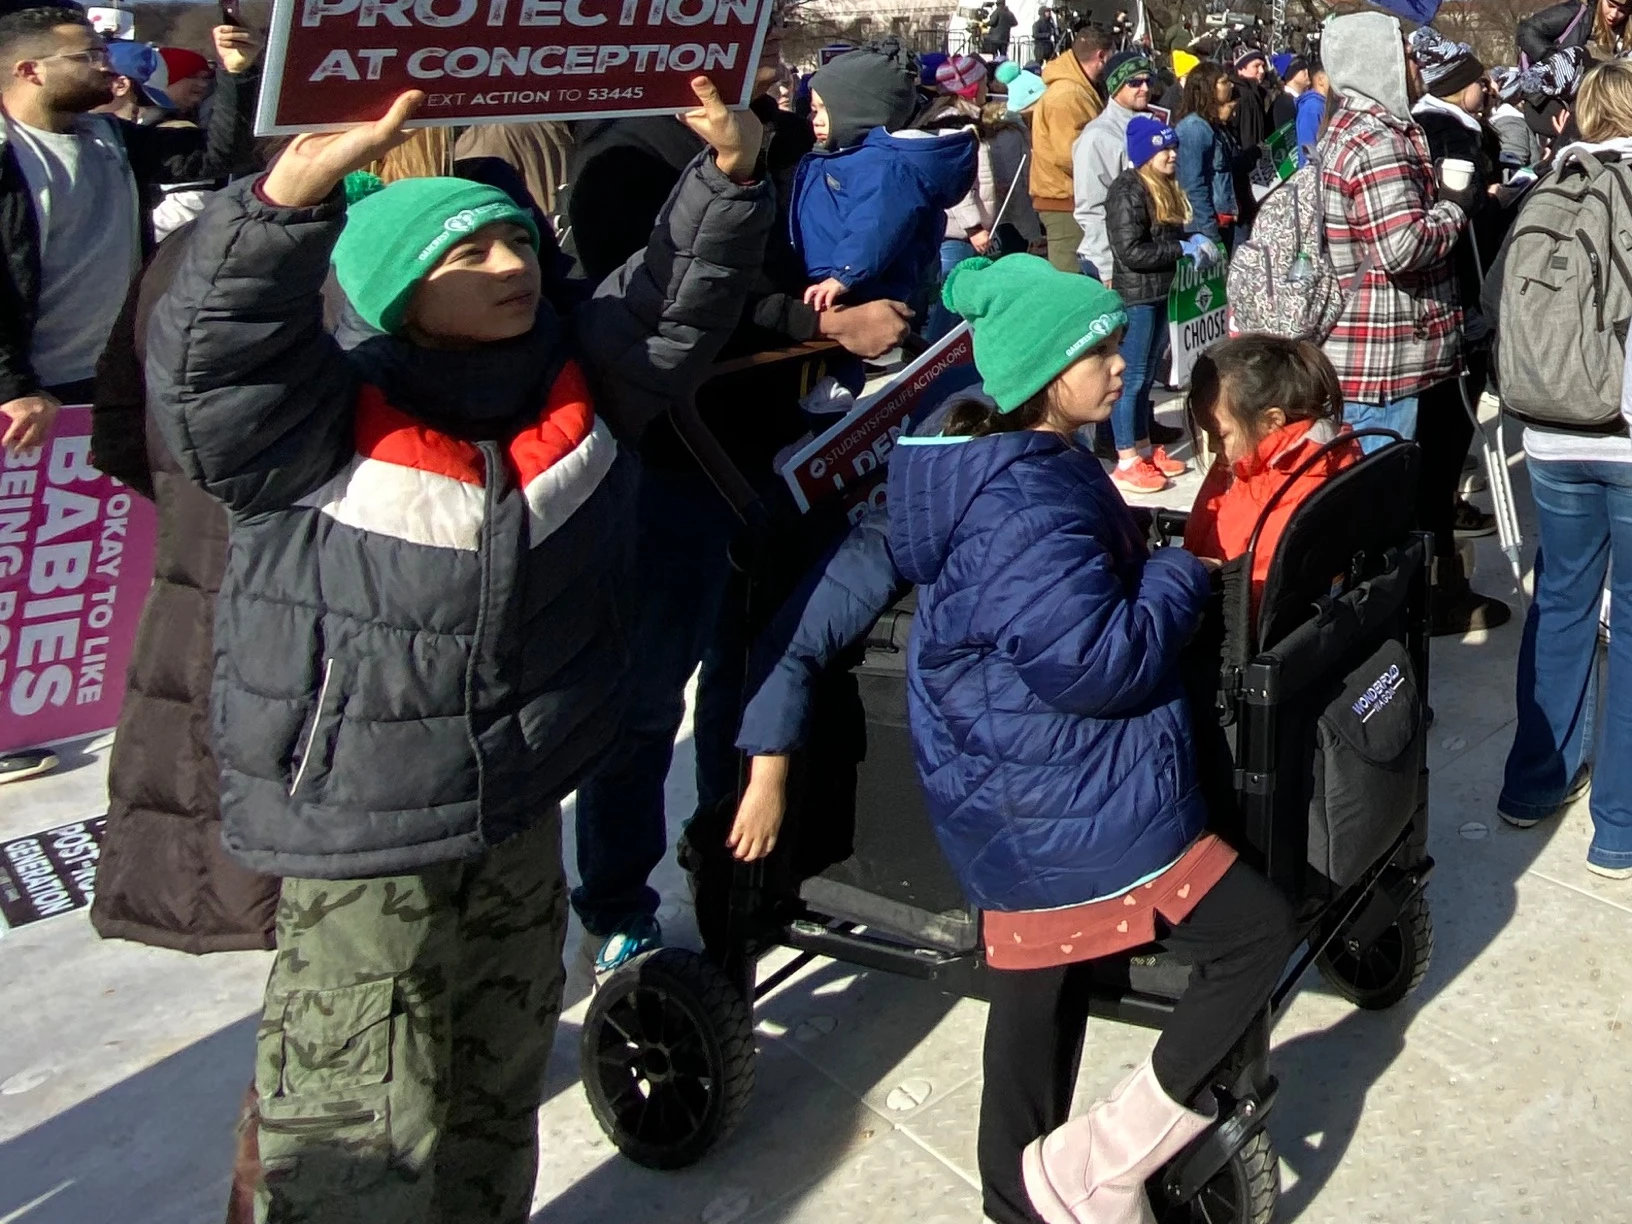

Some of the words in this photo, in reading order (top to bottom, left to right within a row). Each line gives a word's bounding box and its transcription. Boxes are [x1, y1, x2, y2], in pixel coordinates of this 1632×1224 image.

[308, 48, 399, 82] AT
[406, 42, 739, 80] CONCEPTION
[424, 92, 466, 107] EXT
[470, 89, 550, 106] ACTION
[557, 89, 582, 102] TO
[587, 86, 644, 101] 53445
[1184, 310, 1227, 352] CHOOSE
[0, 449, 43, 576] BEING
[95, 493, 132, 578] OKAY
[9, 435, 103, 717] BABIES
[87, 585, 118, 629] TO
[75, 635, 110, 706] LIKE
[1352, 664, 1400, 715] WONDERFOLD
[1373, 686, 1396, 712] WAGON
[4, 838, 75, 916] GENERATION
